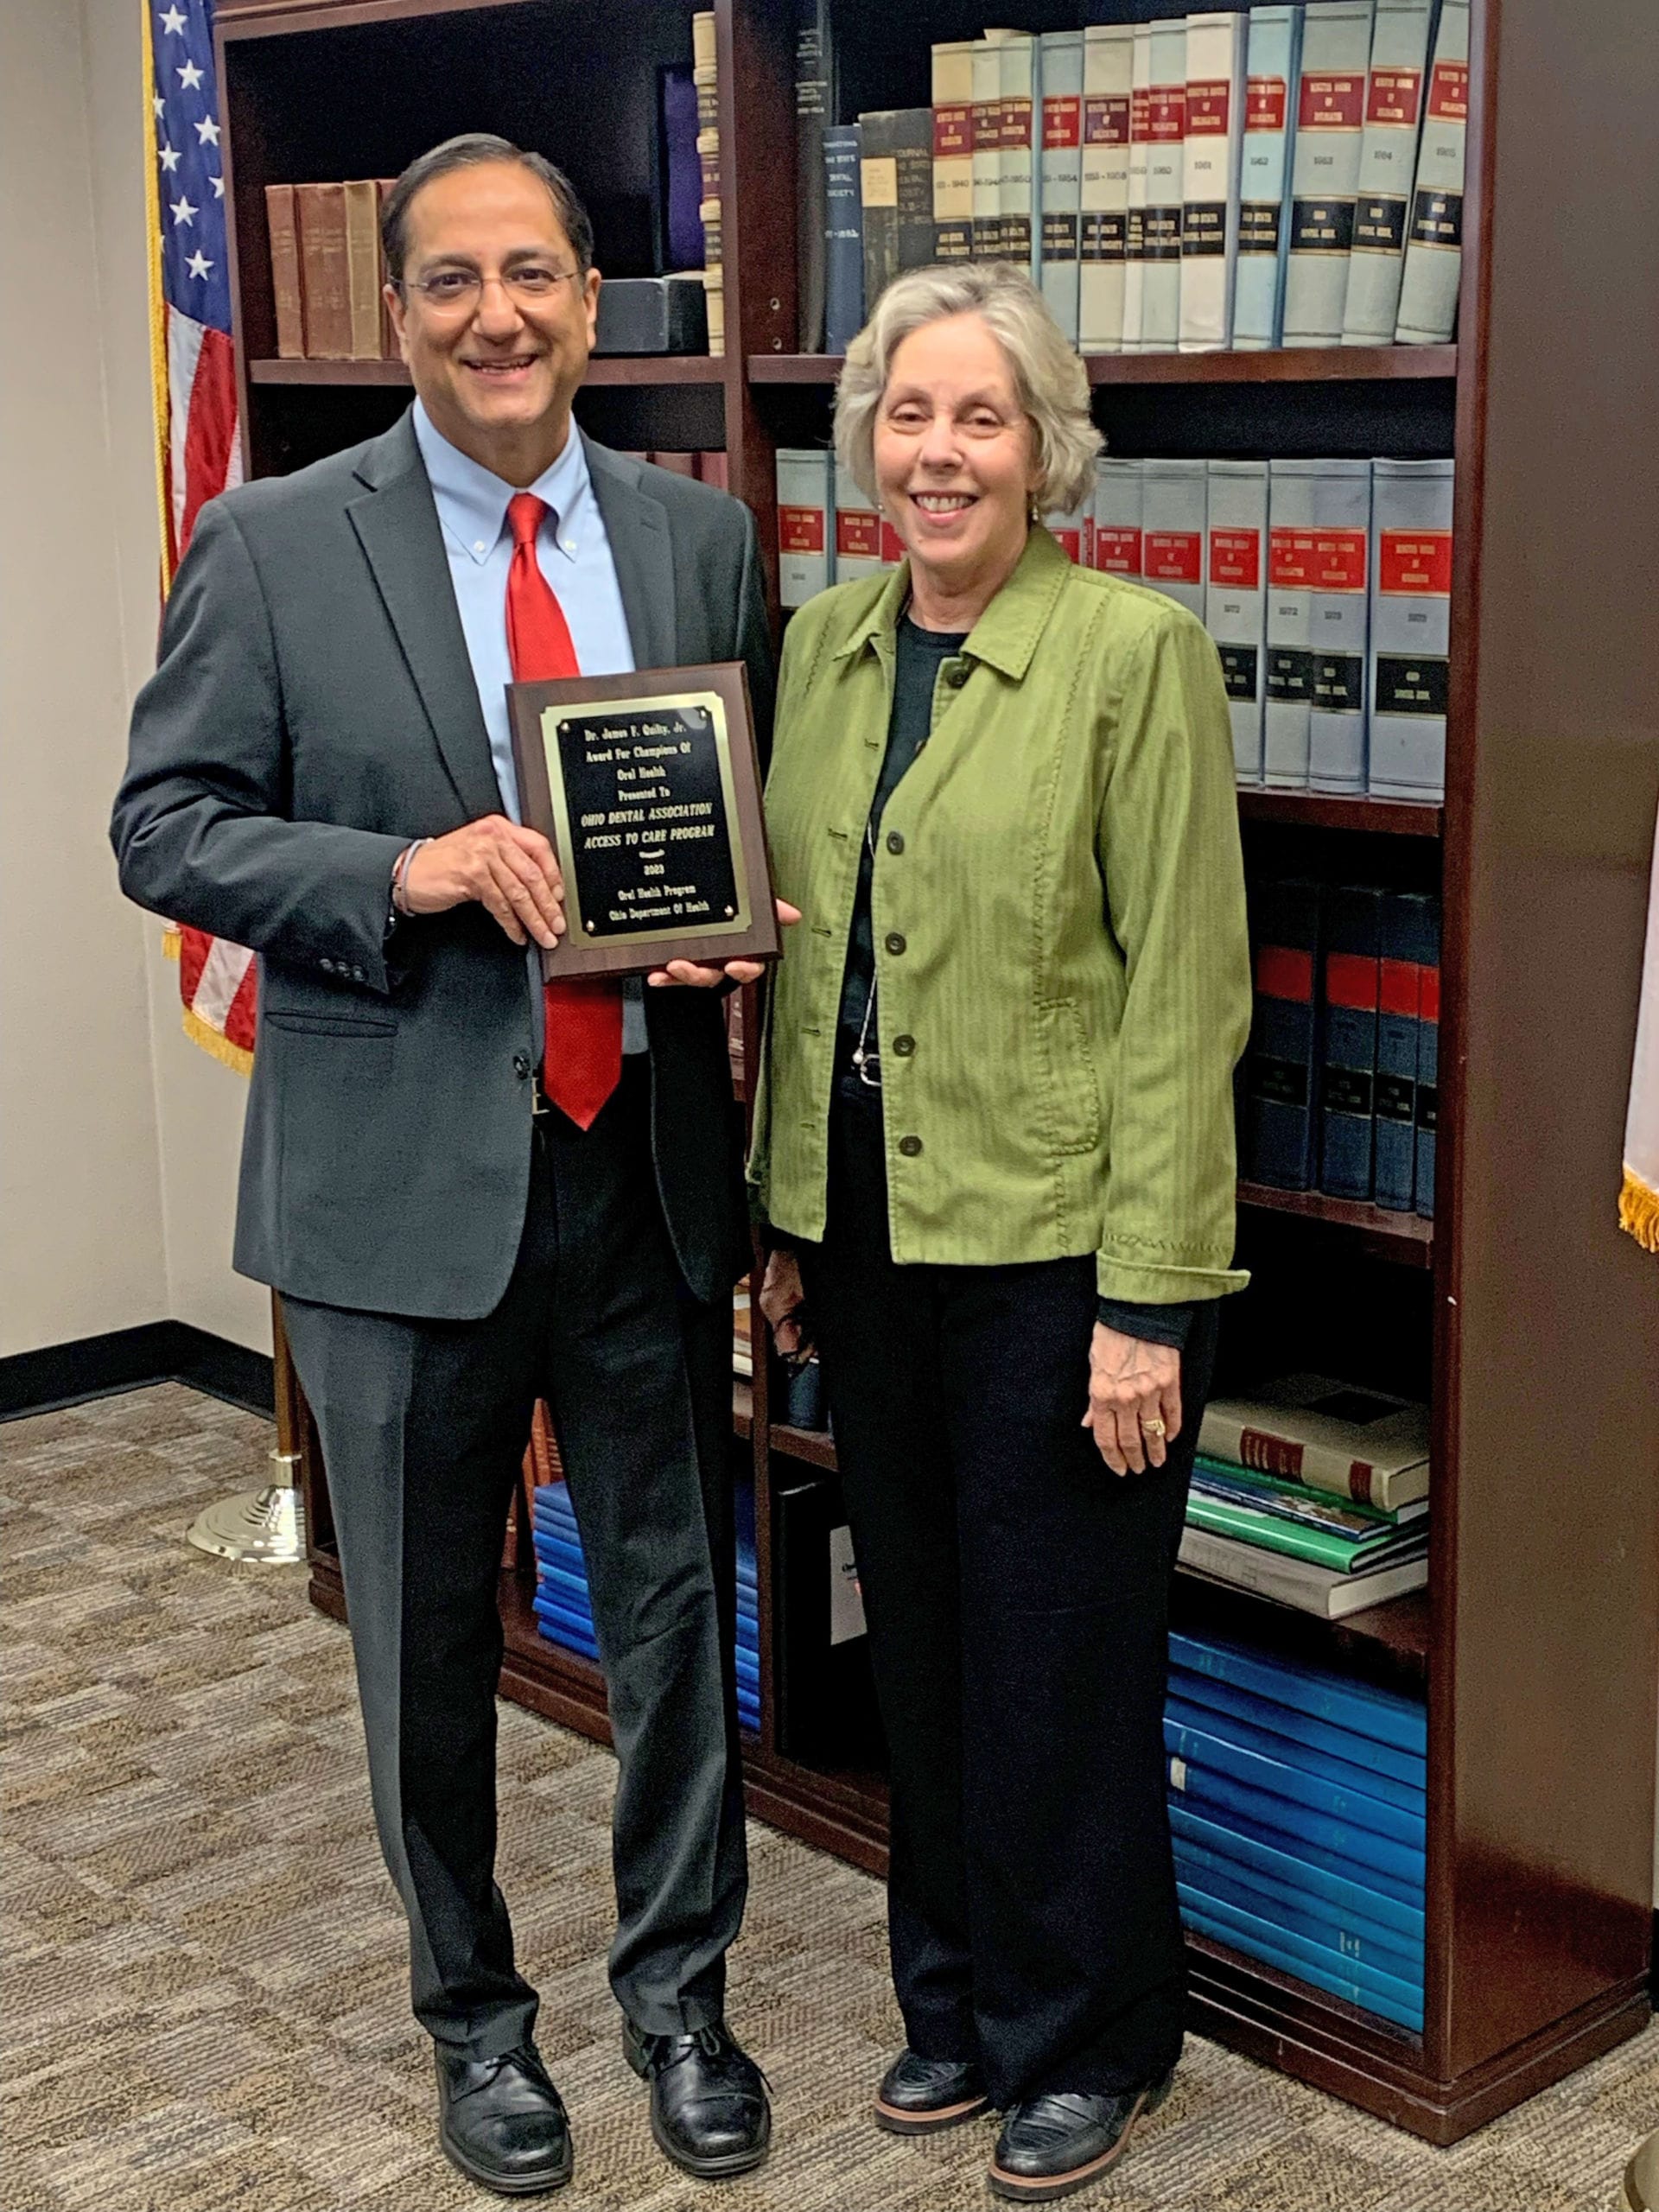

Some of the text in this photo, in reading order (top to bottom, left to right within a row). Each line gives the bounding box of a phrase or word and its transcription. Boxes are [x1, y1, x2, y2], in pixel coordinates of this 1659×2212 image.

[583, 728, 600, 742] Dr.
[601, 727, 629, 741] James
[586, 741, 692, 763] Award For Champions Of
[616, 765, 667, 781] Oral Health
[617, 785, 671, 803] Presented To
[580, 802, 714, 828] OHIO DENTAL ASSOCIATION
[583, 823, 716, 849] ACCESS TO CARE PROGRAM
[643, 863, 665, 876] 2023
[617, 884, 697, 901] Oral Health Program
[608, 899, 711, 922] Ohio Department Of Health
